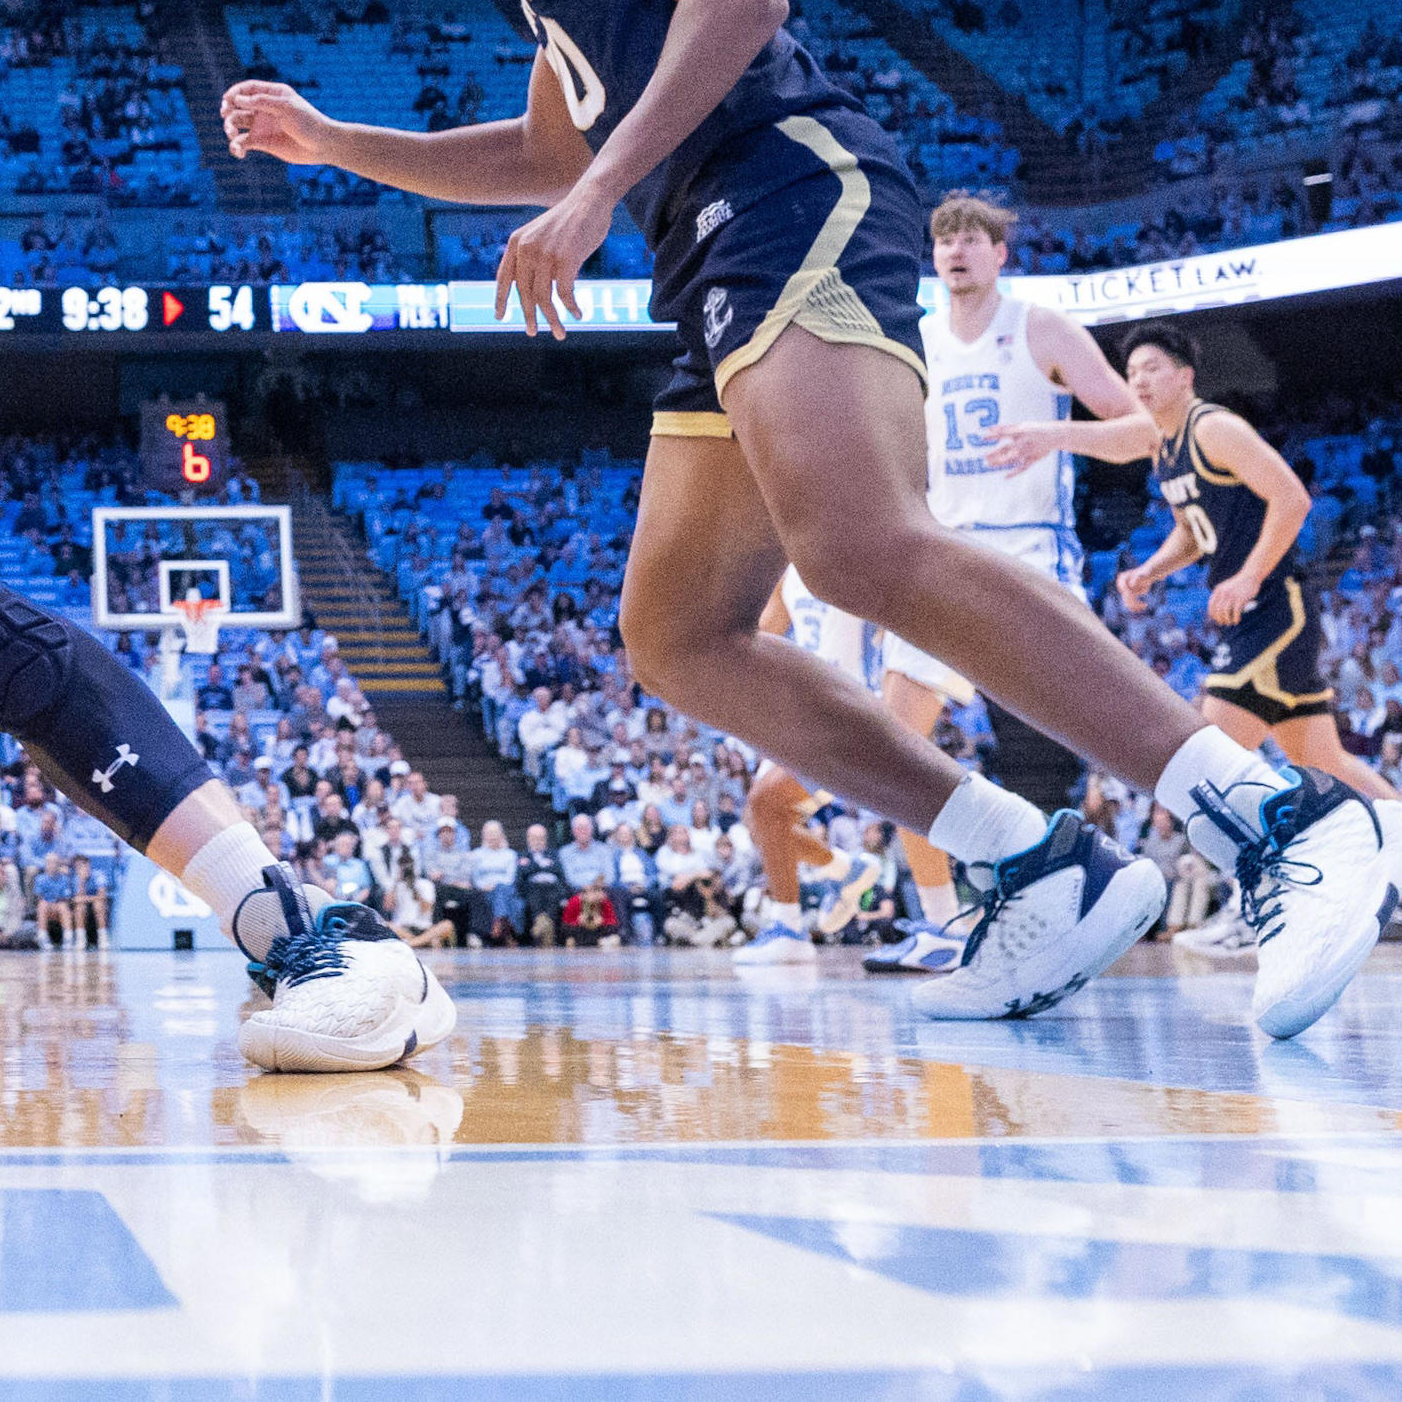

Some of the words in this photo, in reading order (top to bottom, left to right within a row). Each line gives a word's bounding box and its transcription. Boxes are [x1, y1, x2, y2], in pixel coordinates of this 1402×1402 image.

[61, 286, 149, 332] 9:38
[208, 284, 255, 332] 54
[165, 413, 216, 441] 9:38
[943, 397, 1000, 451] 13
